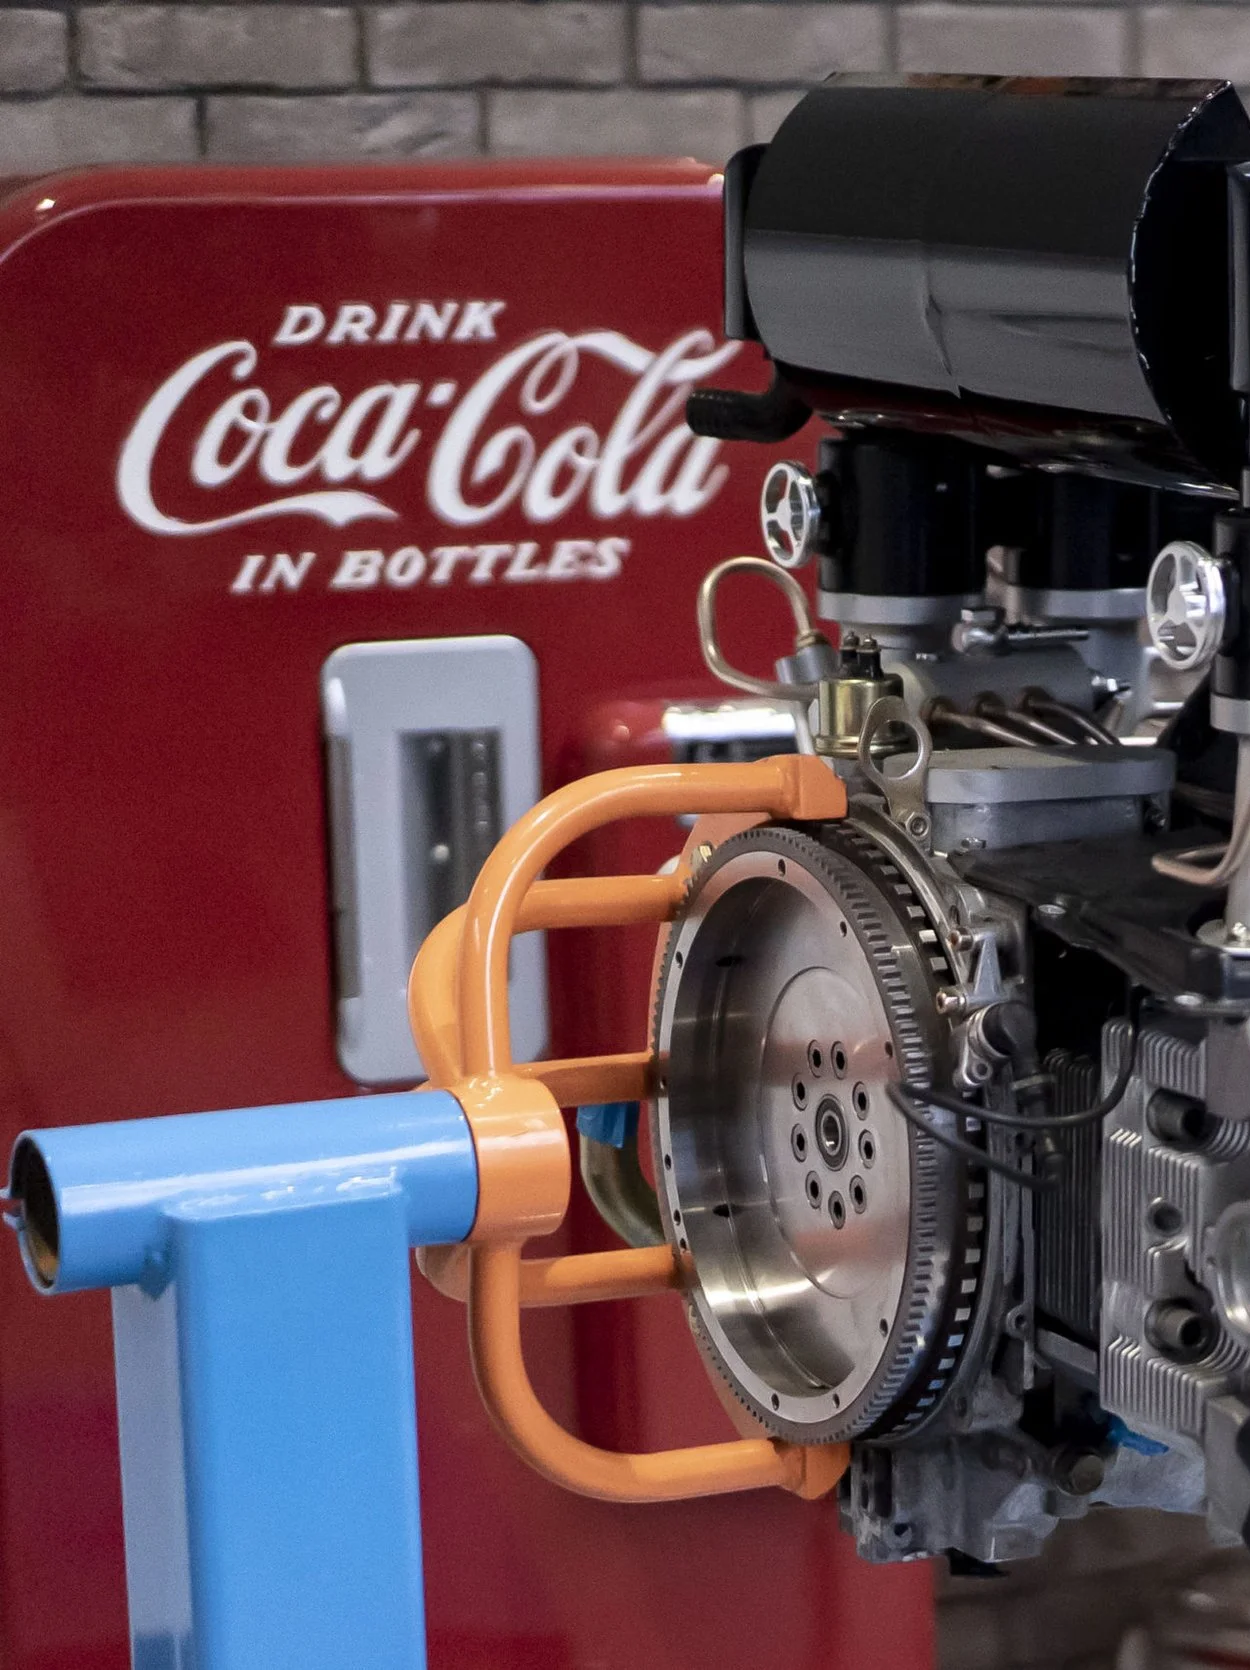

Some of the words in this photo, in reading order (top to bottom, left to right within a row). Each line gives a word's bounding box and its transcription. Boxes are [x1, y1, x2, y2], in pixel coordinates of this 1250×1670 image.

[273, 299, 506, 346] DRINK
[229, 551, 317, 593] IN
[332, 537, 631, 588] BOTTLES
